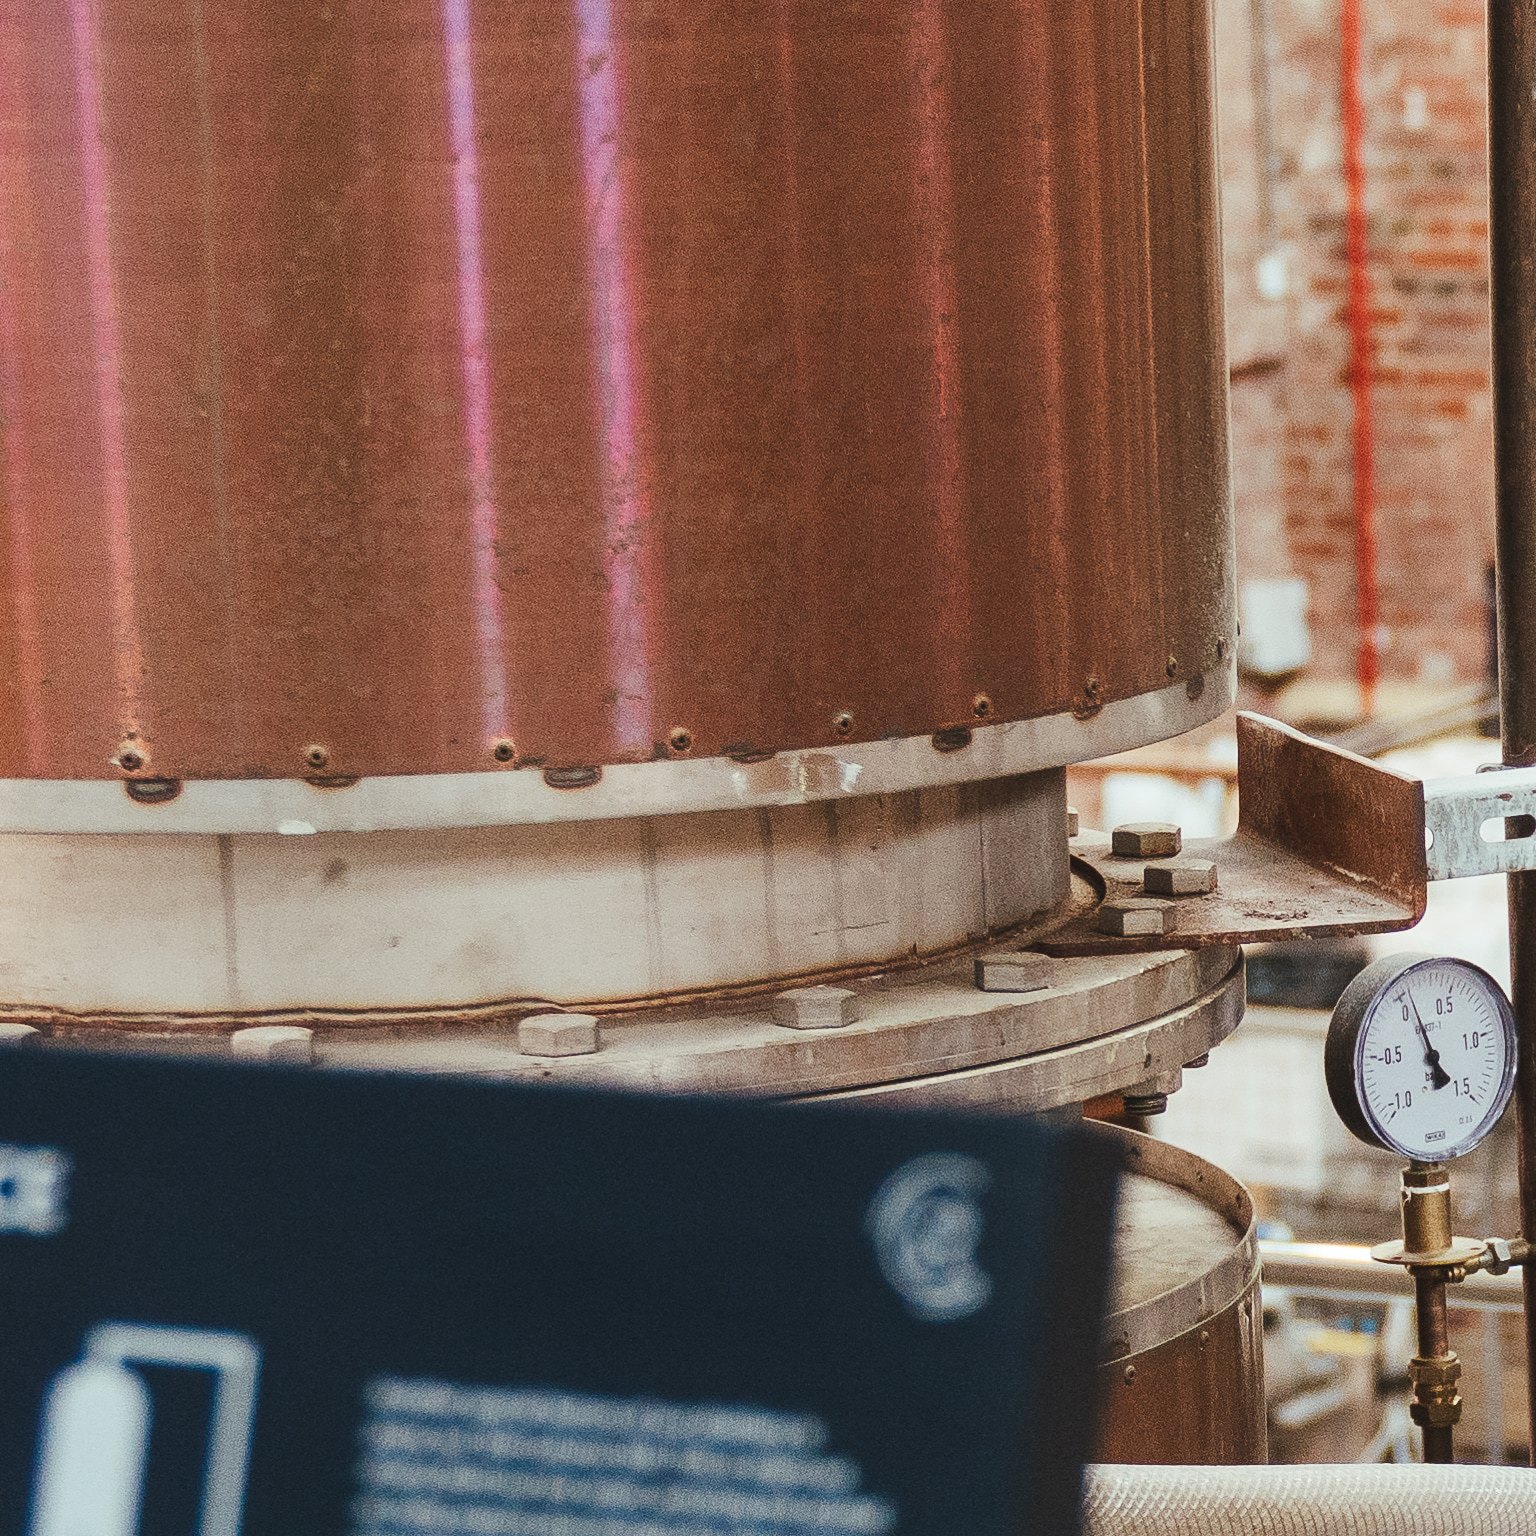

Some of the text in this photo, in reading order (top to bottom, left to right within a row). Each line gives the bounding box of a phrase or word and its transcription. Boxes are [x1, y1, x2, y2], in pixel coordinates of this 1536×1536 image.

[1402, 1005, 1409, 1021] 0
[1435, 996, 1453, 1015] 0.5
[1463, 1031, 1479, 1050] 1.0
[1453, 1078, 1470, 1097] 1.5
